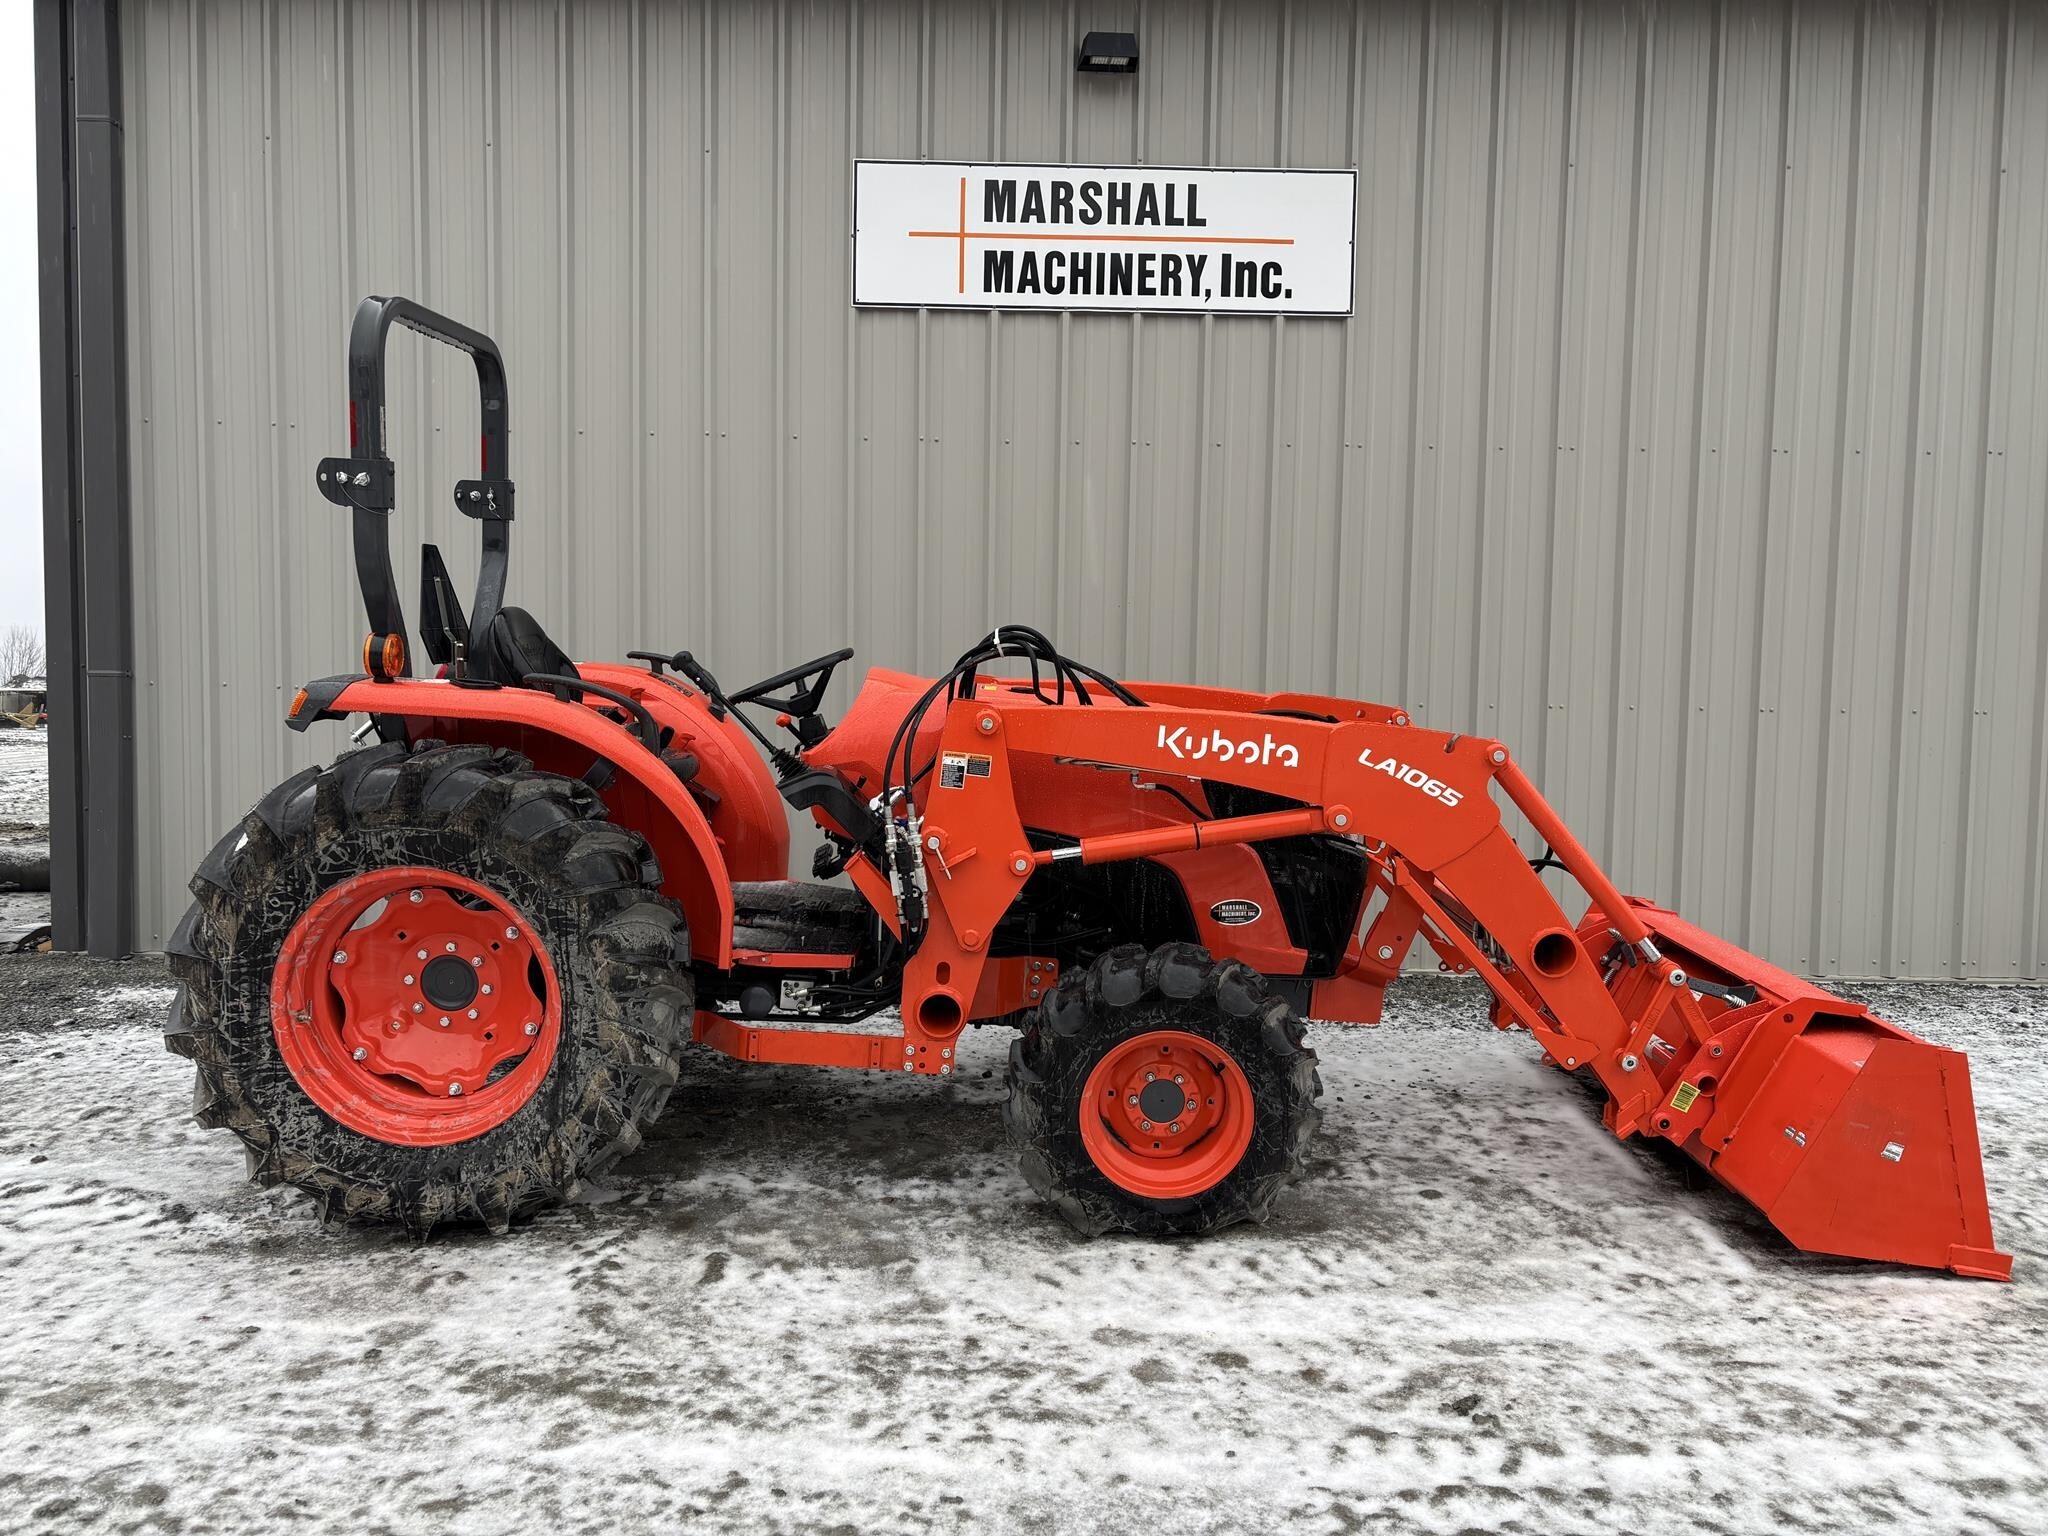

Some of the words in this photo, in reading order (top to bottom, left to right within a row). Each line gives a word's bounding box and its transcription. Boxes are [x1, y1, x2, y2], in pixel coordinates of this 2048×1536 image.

[983, 179, 1207, 227] MARSHALL
[983, 250, 1211, 303] MACHINERY,
[1220, 253, 1293, 299] Inc.
[1157, 725, 1299, 768] Kubota
[1358, 748, 1464, 807] LA1065
